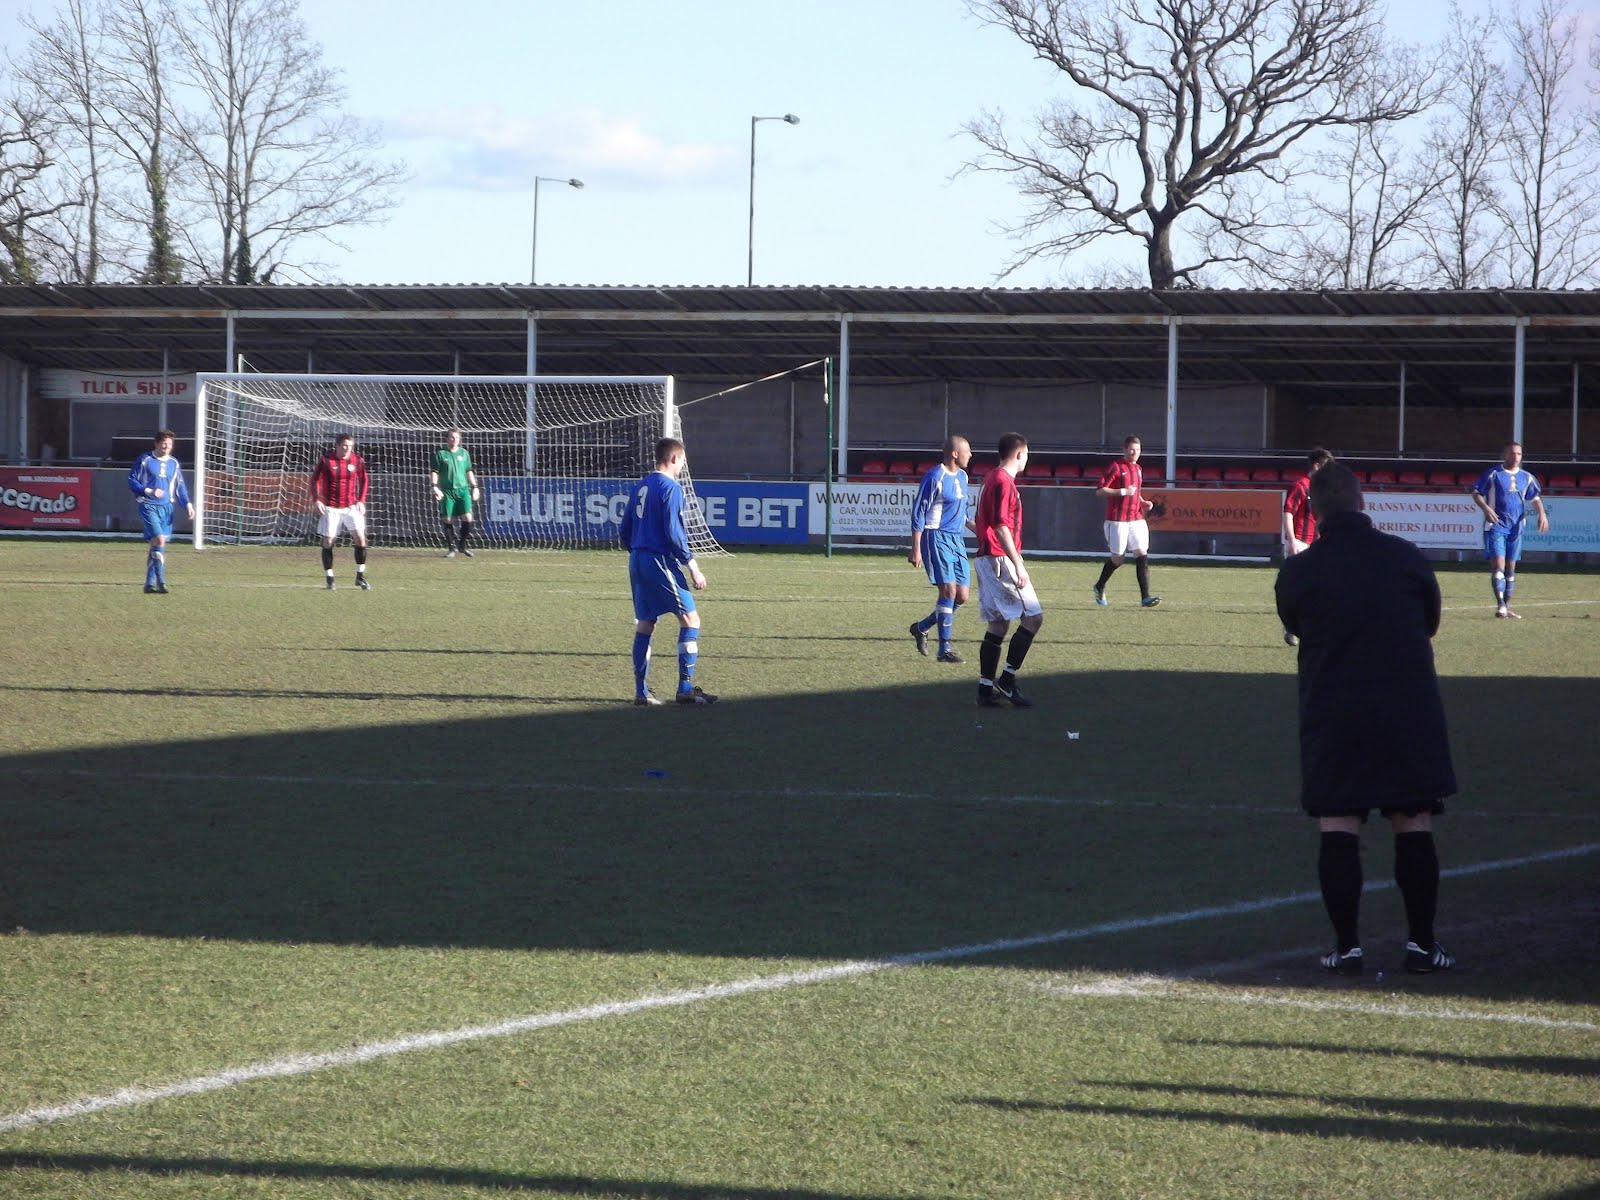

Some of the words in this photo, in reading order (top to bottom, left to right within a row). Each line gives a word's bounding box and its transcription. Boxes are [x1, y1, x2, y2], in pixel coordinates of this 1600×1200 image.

[80, 381, 128, 394] TUCK
[137, 381, 187, 395] SHOP
[636, 485, 649, 520] 3
[1424, 503, 1477, 514] EXPRESS
[490, 493, 574, 524] BLUE
[737, 497, 804, 529] BET
[840, 506, 859, 517] CAR,
[861, 507, 880, 516] VAN
[882, 507, 901, 517] AND
[1172, 507, 1198, 519] OAK
[1200, 508, 1263, 520] PROPERTY
[1371, 521, 1421, 533] ARRIERS
[1423, 523, 1475, 534] LIMITED
